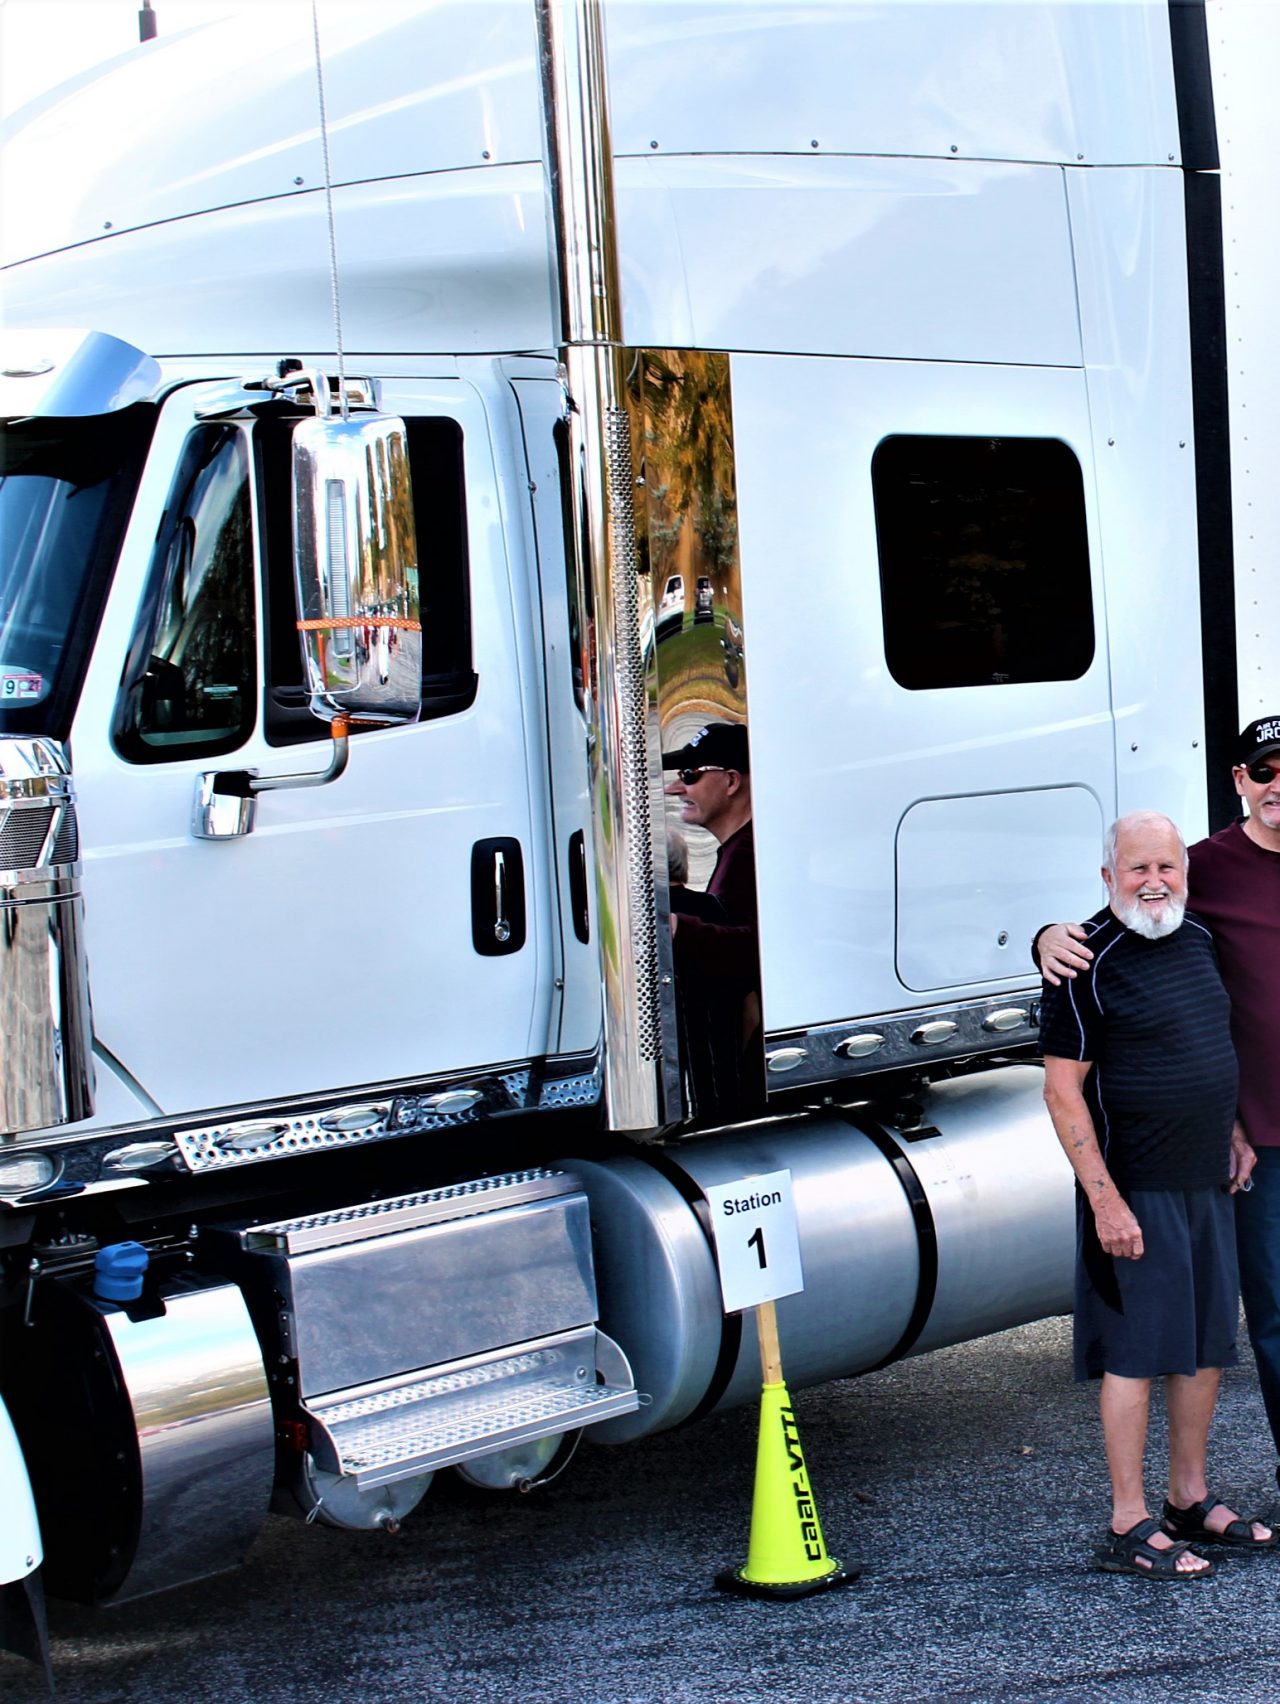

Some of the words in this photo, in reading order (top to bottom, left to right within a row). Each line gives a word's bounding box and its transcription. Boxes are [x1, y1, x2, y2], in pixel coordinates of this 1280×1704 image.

[6, 680, 15, 695] 9
[1256, 722, 1271, 731] AIR
[723, 1191, 782, 1216] Station
[747, 1227, 767, 1269] 1
